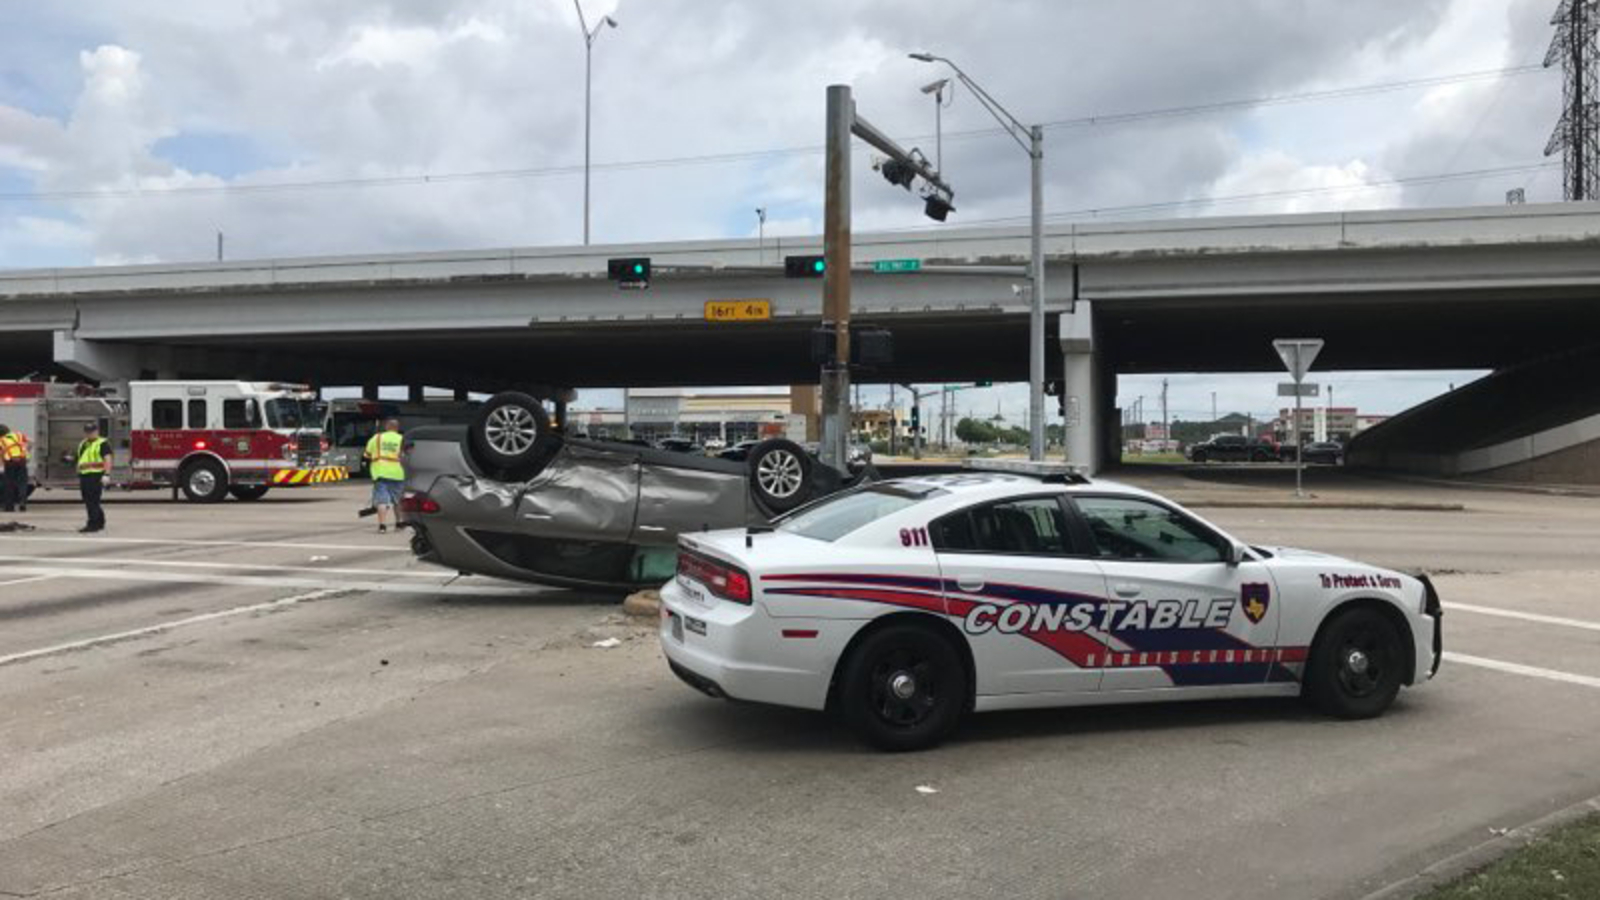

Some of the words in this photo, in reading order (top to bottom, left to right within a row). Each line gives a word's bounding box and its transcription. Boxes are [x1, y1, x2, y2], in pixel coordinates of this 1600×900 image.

[711, 305, 736, 317] 16FT
[899, 527, 928, 547] 911
[1319, 573, 1331, 589] To
[1332, 573, 1369, 589] Protect
[964, 599, 1237, 635] CONSTABLE
[1086, 651, 1180, 667] HARRIS
[1190, 649, 1285, 664] COUNTY
